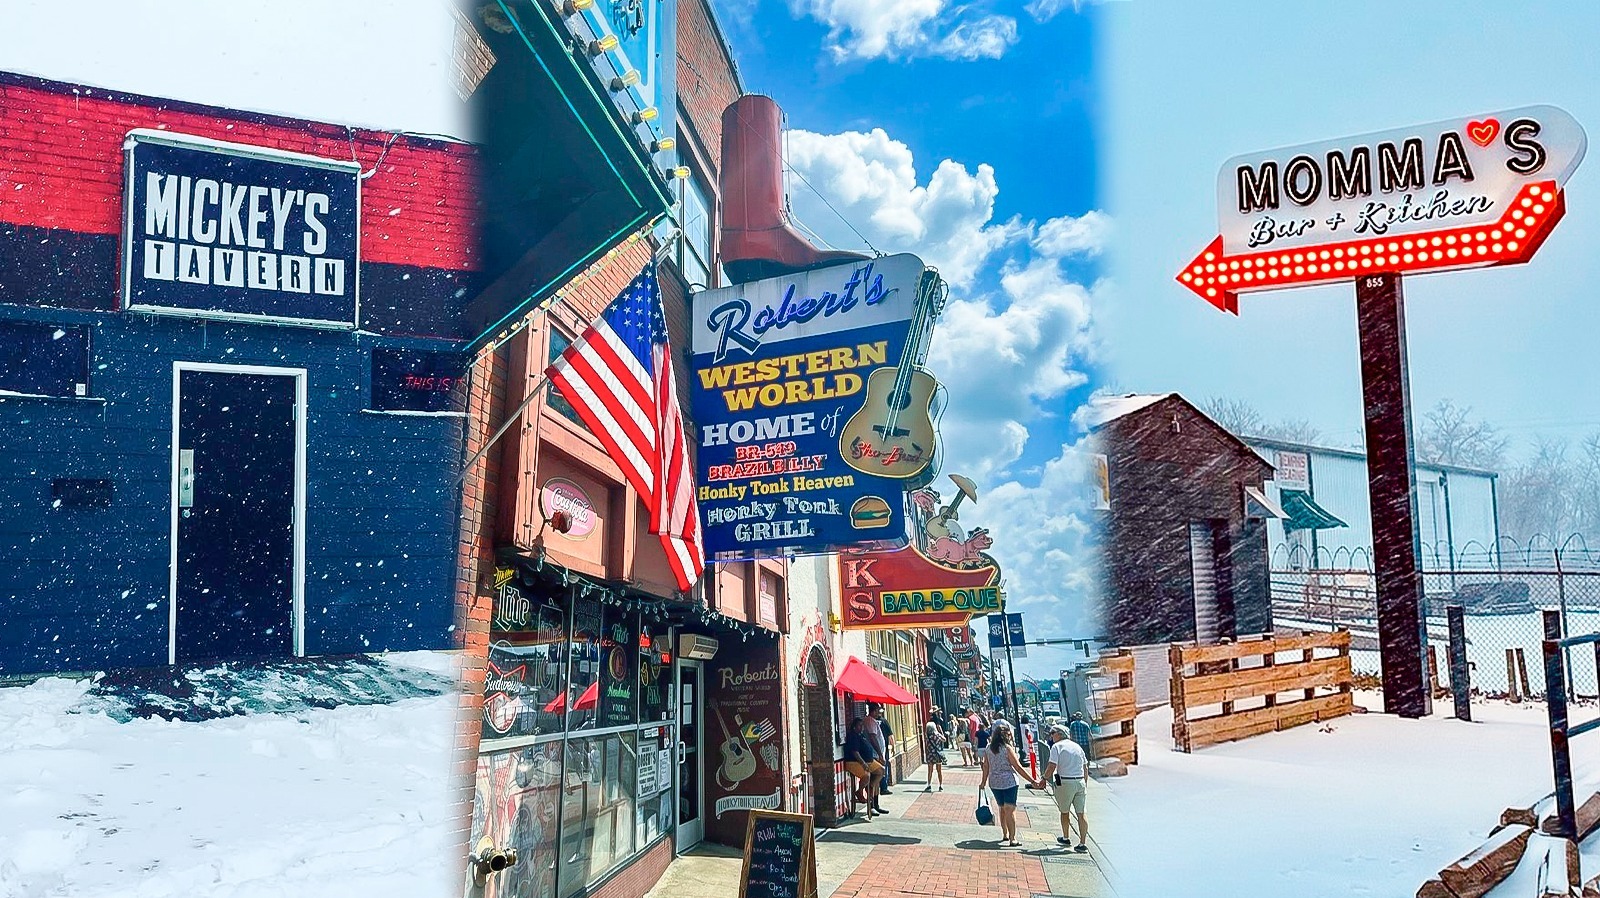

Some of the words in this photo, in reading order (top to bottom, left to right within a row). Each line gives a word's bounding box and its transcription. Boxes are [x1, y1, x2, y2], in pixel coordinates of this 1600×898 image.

[145, 171, 330, 255] MICKEY'S
[1248, 215, 1314, 248] Bar
[1354, 192, 1495, 235] Kitchen
[154, 243, 338, 293] TAVERN
[1366, 276, 1384, 288] 855
[706, 264, 899, 363] Robert's
[697, 341, 889, 391] WESTERN
[723, 374, 863, 412] WORLD
[702, 412, 816, 446] HOME
[821, 405, 846, 437] of
[735, 441, 797, 462] BR-549
[697, 482, 748, 501] Honky
[750, 478, 790, 496] Tonk
[793, 474, 854, 491] Heaven
[707, 500, 778, 526] Honky
[782, 496, 843, 516] Tonk
[734, 518, 816, 543] GRILL
[495, 584, 530, 632] Lite
[883, 588, 999, 613] BAR-B-QUE
[718, 662, 779, 689] Robert's
